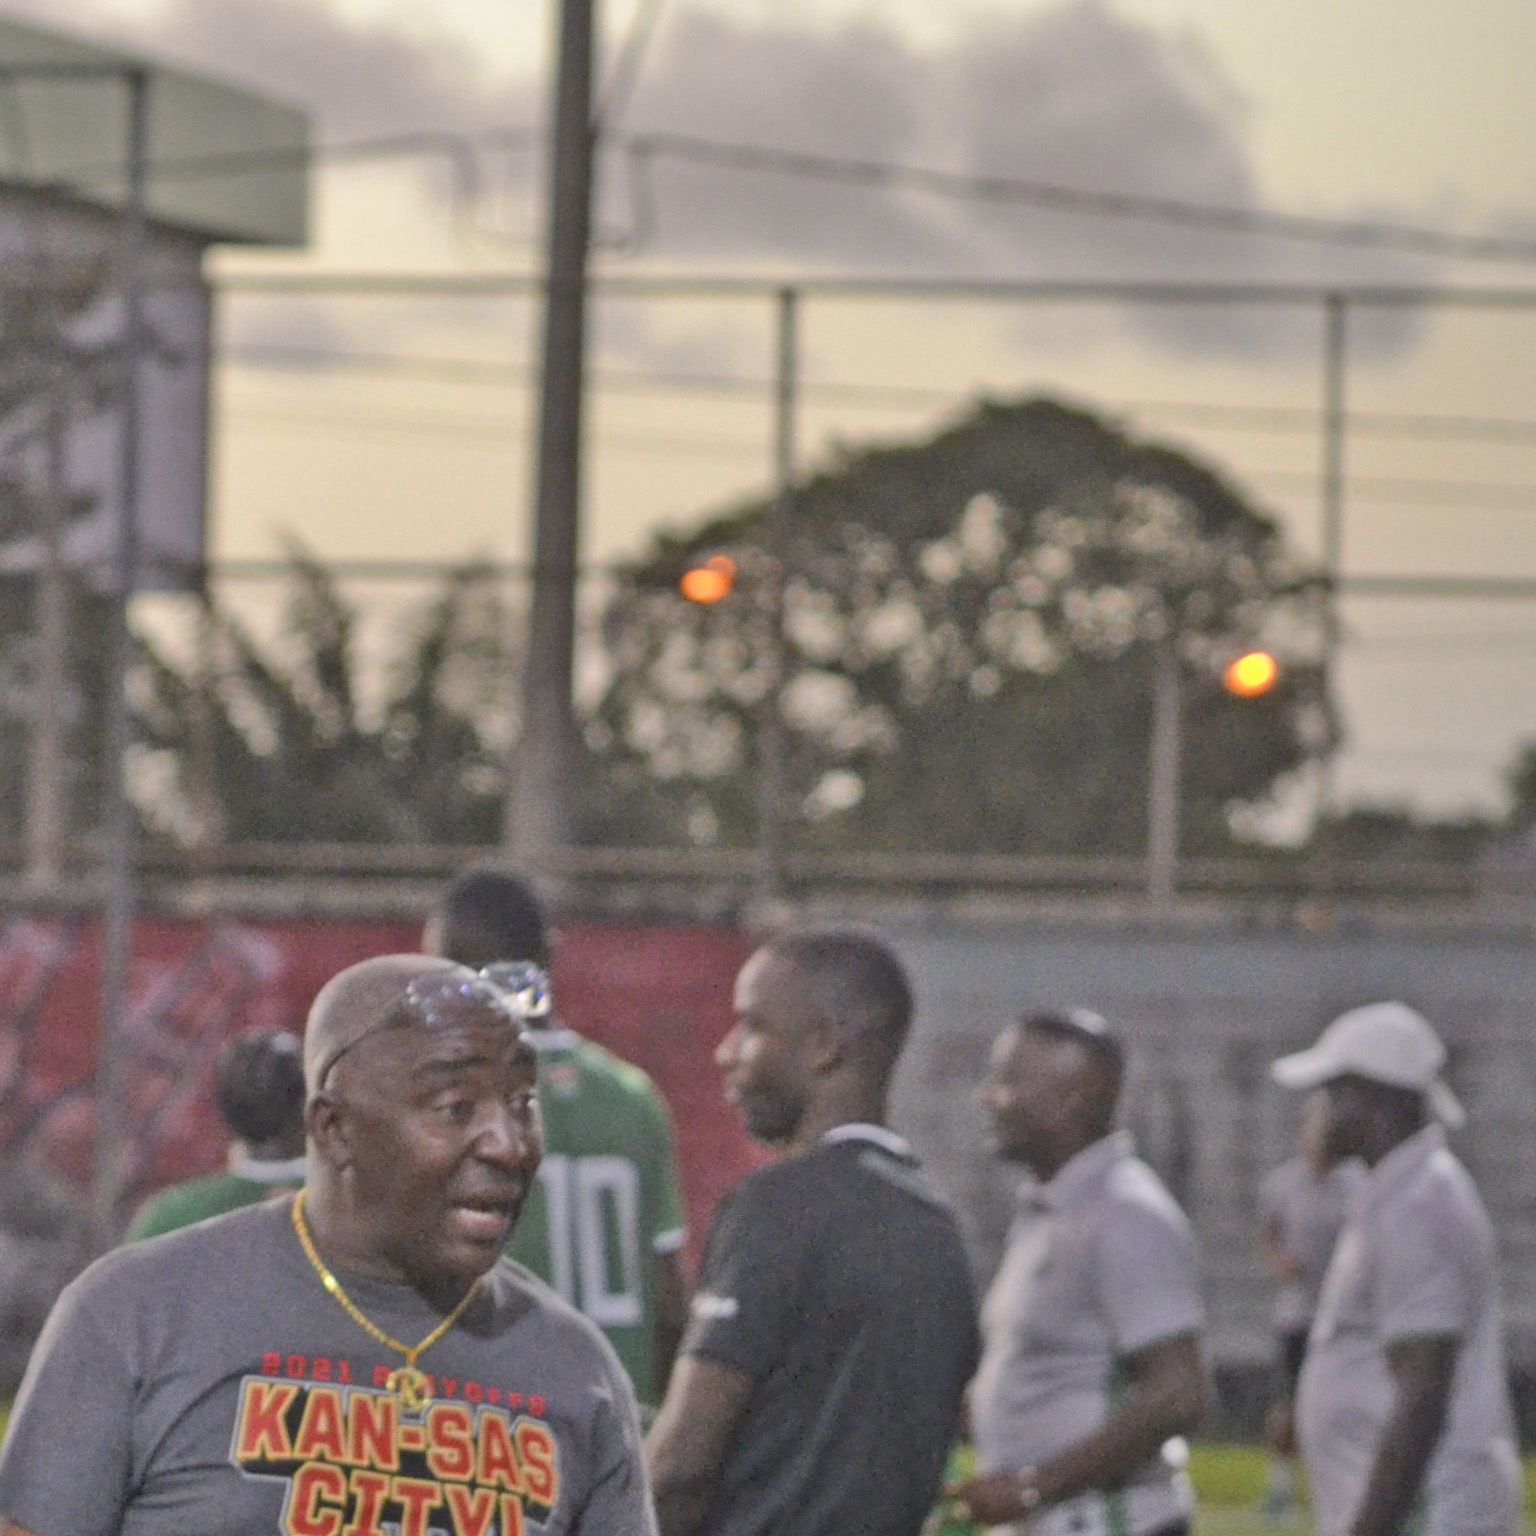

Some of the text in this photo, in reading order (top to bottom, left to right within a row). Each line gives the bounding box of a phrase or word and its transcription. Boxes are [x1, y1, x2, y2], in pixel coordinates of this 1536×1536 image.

[536, 1154, 643, 1327] 10
[234, 1380, 563, 1509] KAN-SAS
[261, 1351, 546, 1418] 2021 PYOFFS
